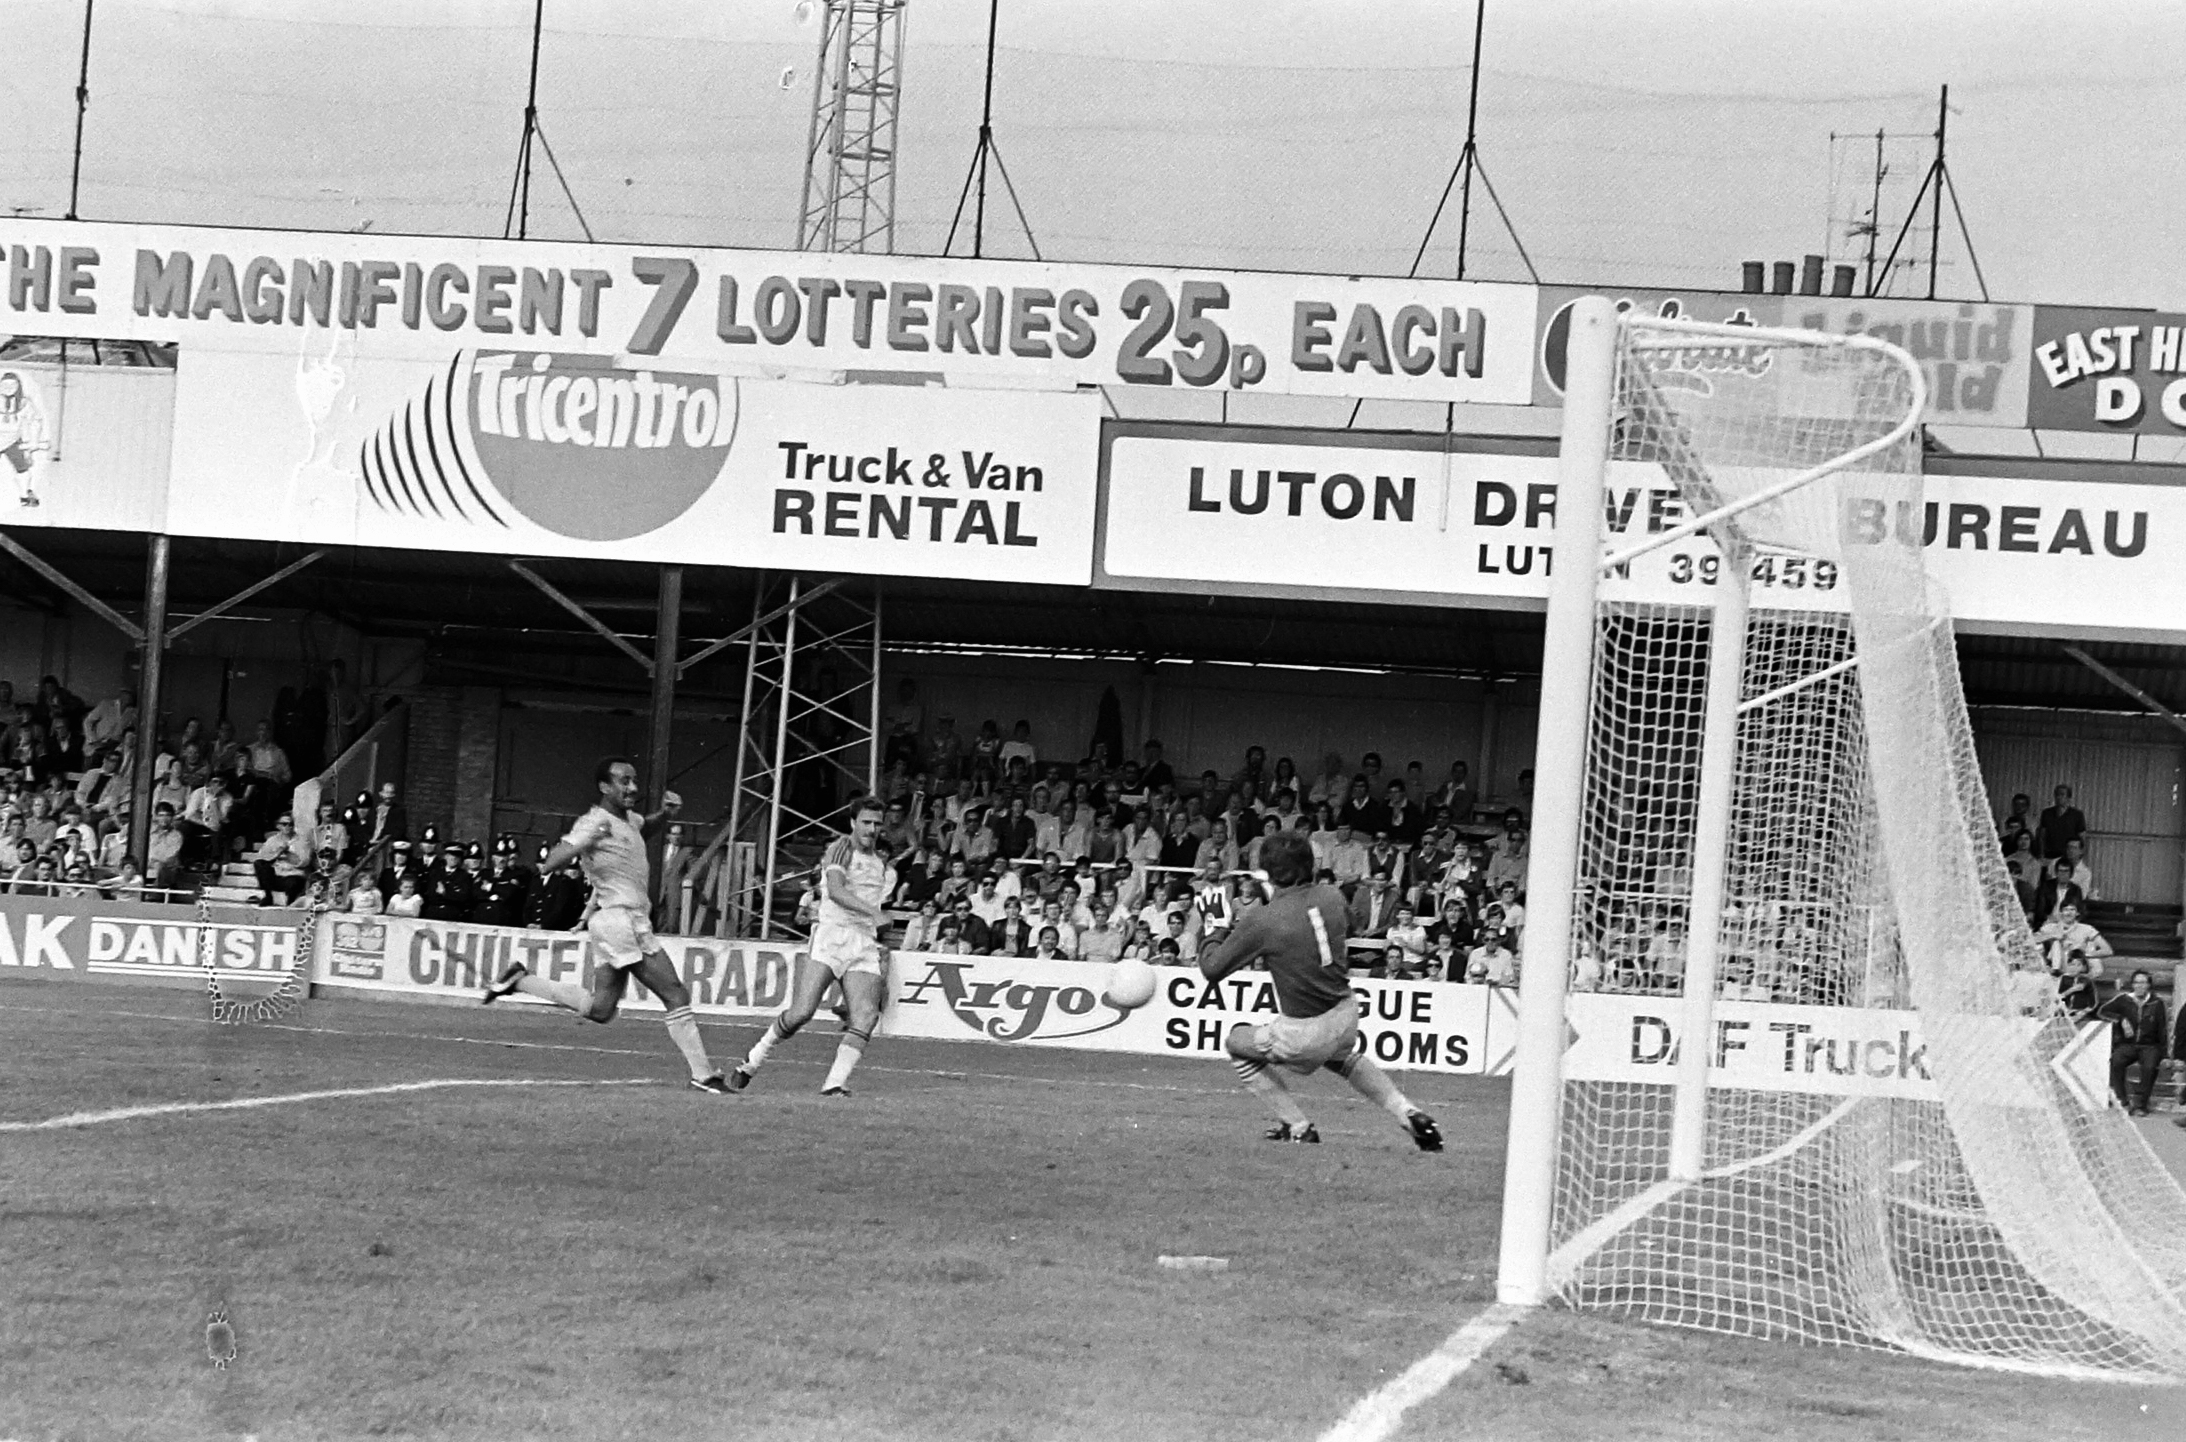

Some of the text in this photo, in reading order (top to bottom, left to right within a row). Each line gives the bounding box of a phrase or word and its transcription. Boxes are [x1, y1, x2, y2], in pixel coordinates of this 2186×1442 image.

[0, 245, 100, 314] HE
[133, 248, 612, 338] MAGNIFICENT
[625, 256, 699, 355] 7
[717, 274, 1098, 358] LOTTERIES
[1116, 279, 1266, 389] 25p
[1292, 300, 1486, 379] EACH
[2035, 325, 2186, 388] EAST H
[473, 353, 737, 449] Tricentrol
[778, 441, 1044, 492] Truck & Van
[772, 489, 1039, 547] RENTAL
[1187, 466, 1417, 523] LUTON
[1846, 496, 2149, 558] BUREAU
[1478, 543, 1631, 581] LUTN
[88, 922, 297, 971] DANISH
[409, 928, 648, 1003] CHILTE
[1307, 906, 1333, 967] 1
[1167, 976, 1433, 1023] CATAGUE
[1165, 1017, 1469, 1067] SHOMS
[1631, 1015, 1751, 1069] DF
